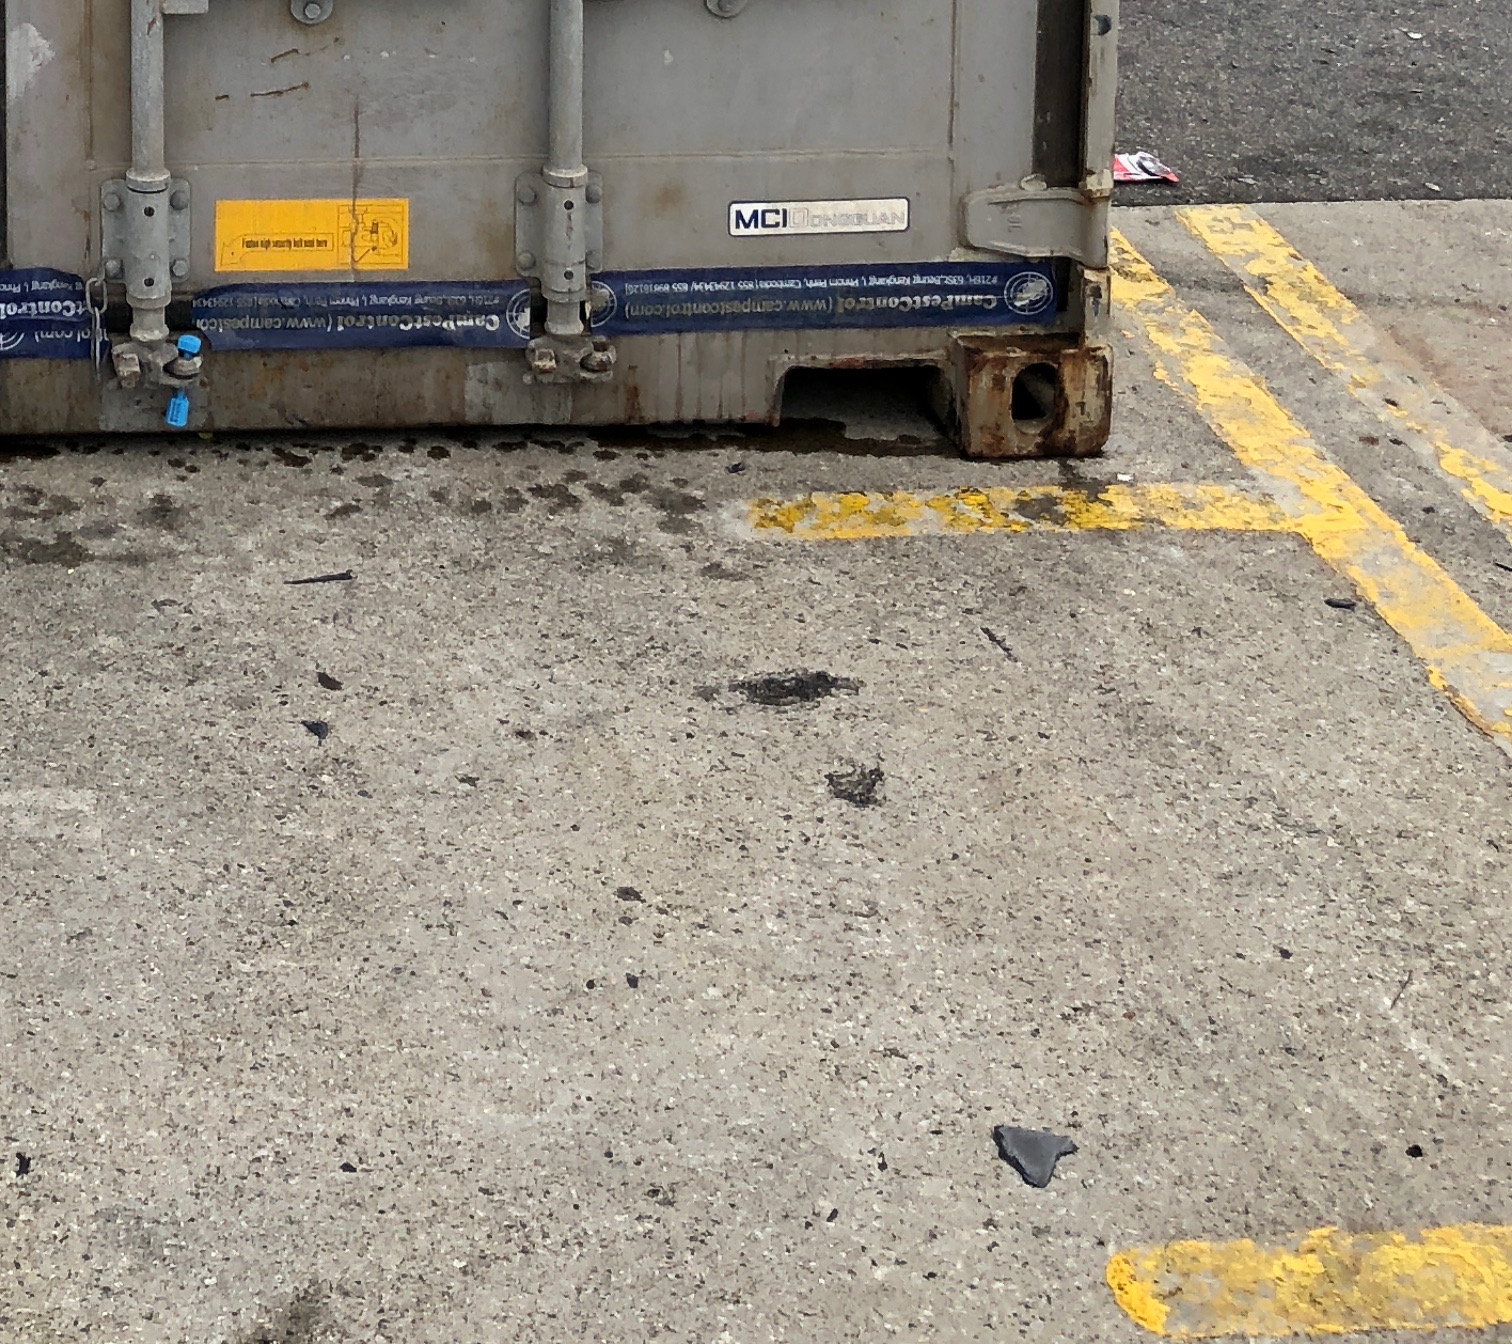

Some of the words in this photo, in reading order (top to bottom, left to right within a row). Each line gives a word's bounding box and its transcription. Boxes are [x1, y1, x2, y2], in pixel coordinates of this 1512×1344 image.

[735, 208, 787, 229] MCI
[837, 293, 998, 311] CamPestControl
[336, 312, 500, 332] CamPestControl
